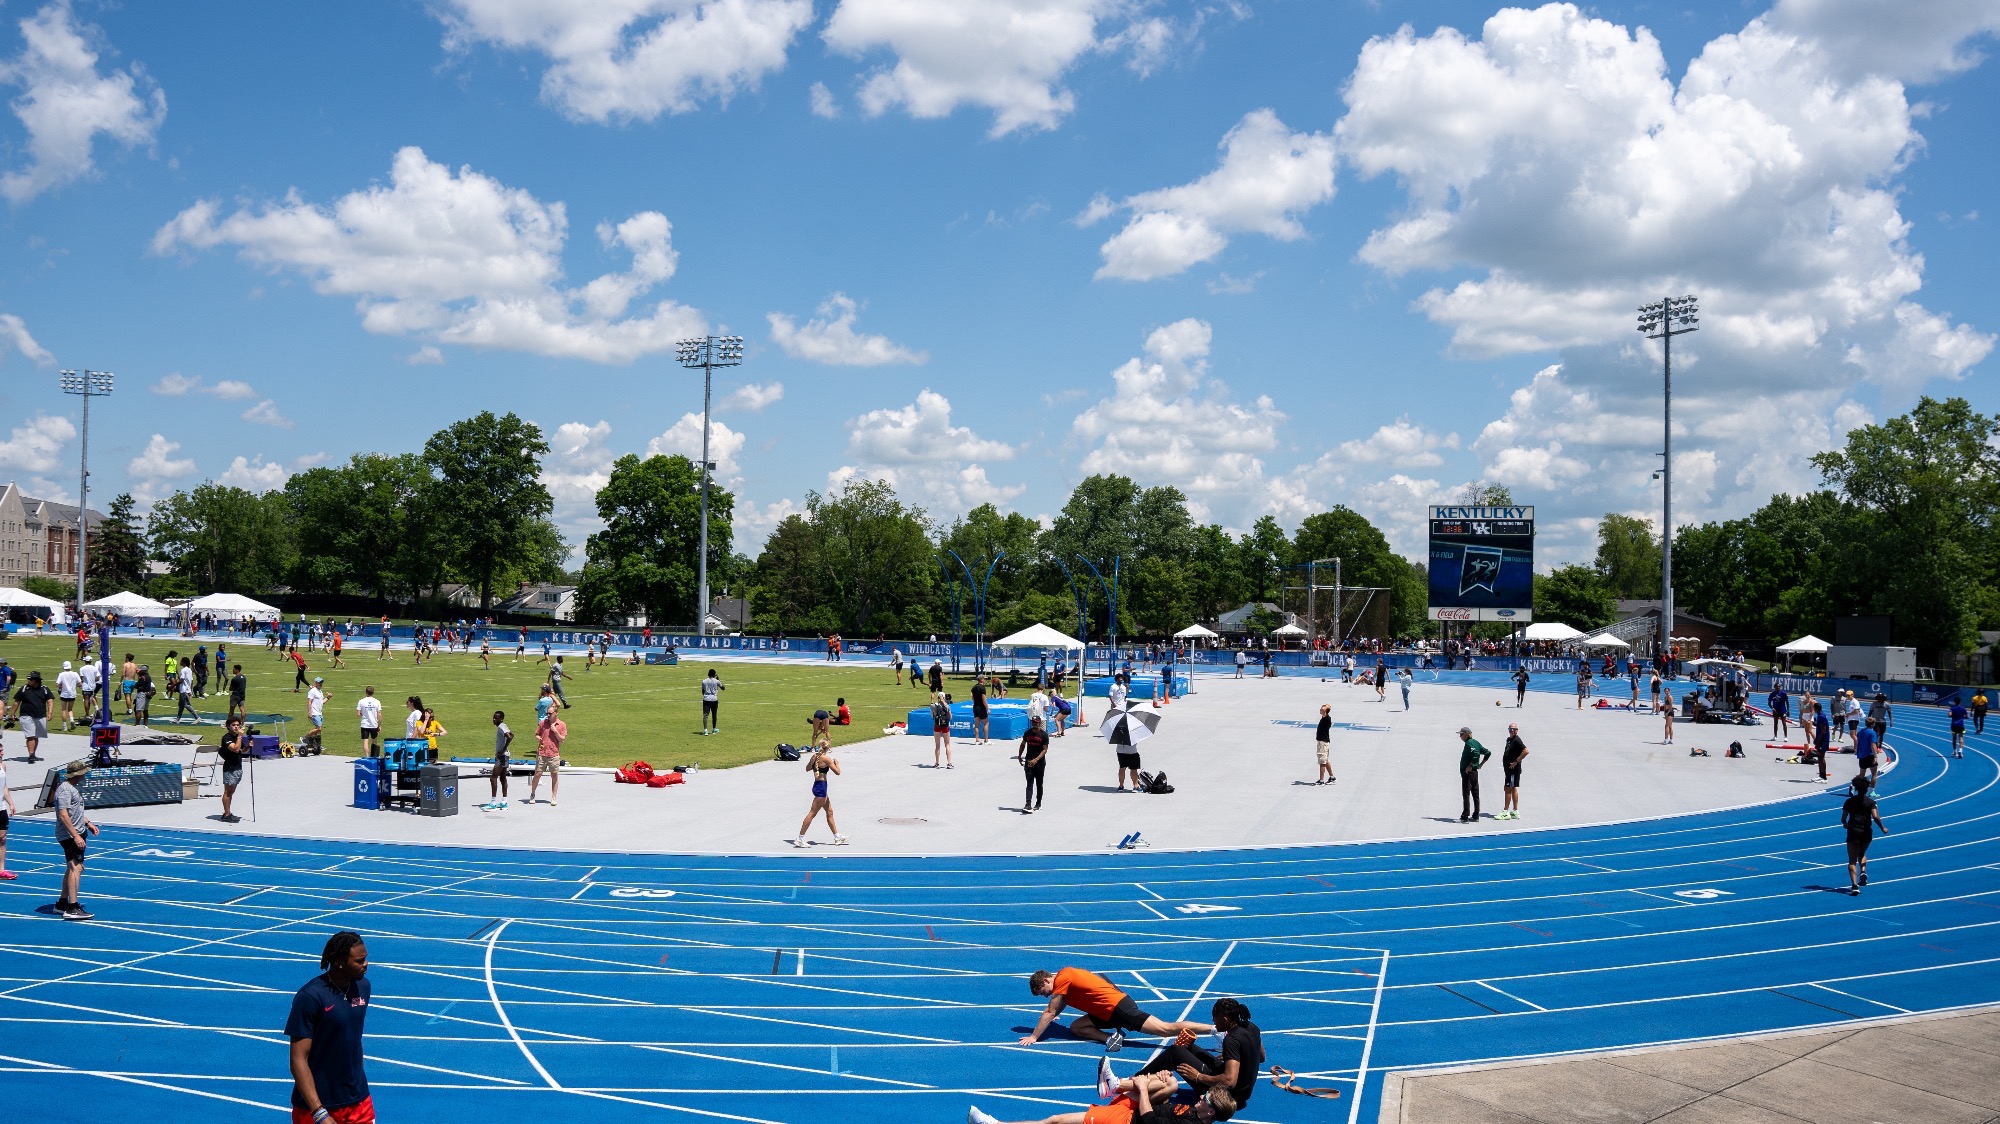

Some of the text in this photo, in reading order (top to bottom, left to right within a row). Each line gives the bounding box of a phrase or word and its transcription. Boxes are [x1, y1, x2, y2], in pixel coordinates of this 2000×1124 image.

[1436, 507, 1527, 519] KENTUCKY
[1437, 607, 1471, 619] Coca-Cola
[552, 632, 631, 645] KENTUKY
[700, 638, 731, 648] AND
[741, 638, 789, 650] FIED
[909, 643, 951, 655] WILDCATS
[1095, 649, 1140, 660] KENUCY
[1520, 659, 1572, 670] KENTUCKY
[1771, 676, 1823, 693] KENTUCKY
[96, 730, 118, 745] 24
[608, 887, 677, 898] 3
[1173, 903, 1243, 914] 4
